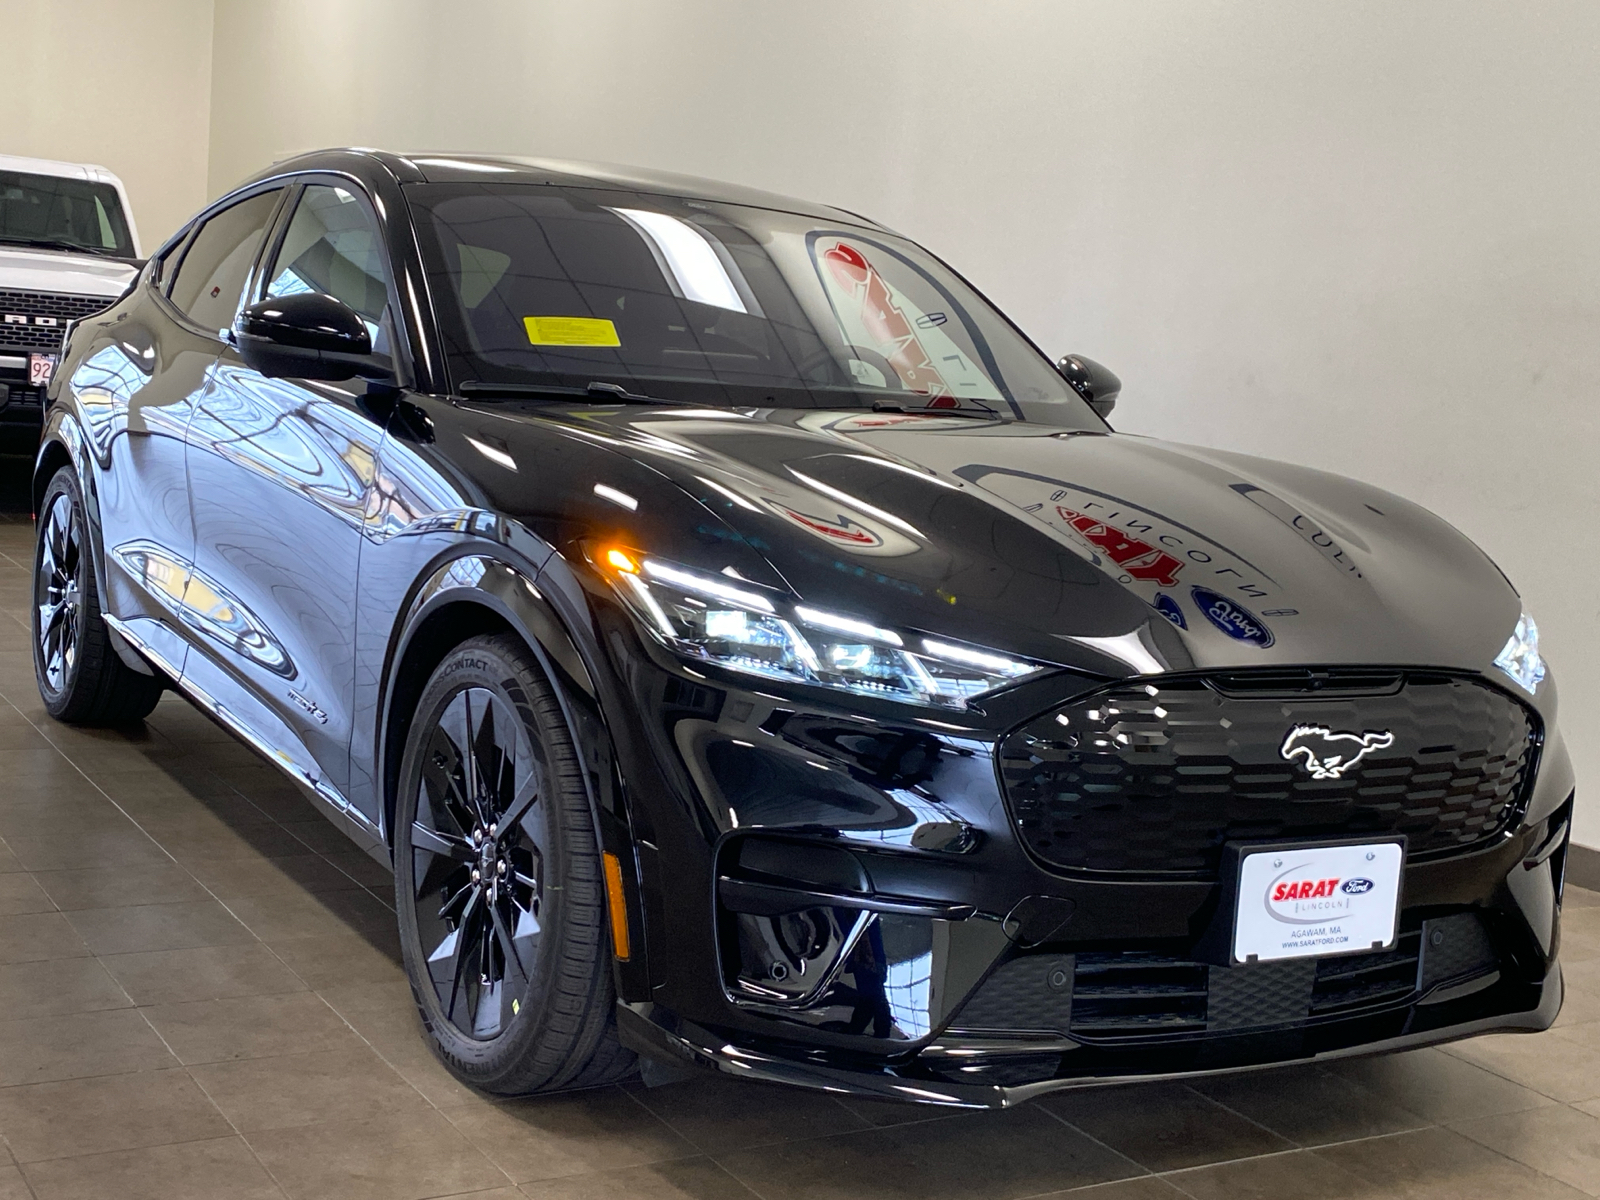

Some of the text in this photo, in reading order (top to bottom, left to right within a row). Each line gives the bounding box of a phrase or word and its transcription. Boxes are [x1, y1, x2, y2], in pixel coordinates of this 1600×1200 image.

[1272, 877, 1370, 902] SARAT Ford
[1301, 901, 1343, 911] LINCOLN
[1291, 926, 1342, 938] AGAWAM, MA
[1282, 936, 1349, 948] WWW.SARATFORD.COM
